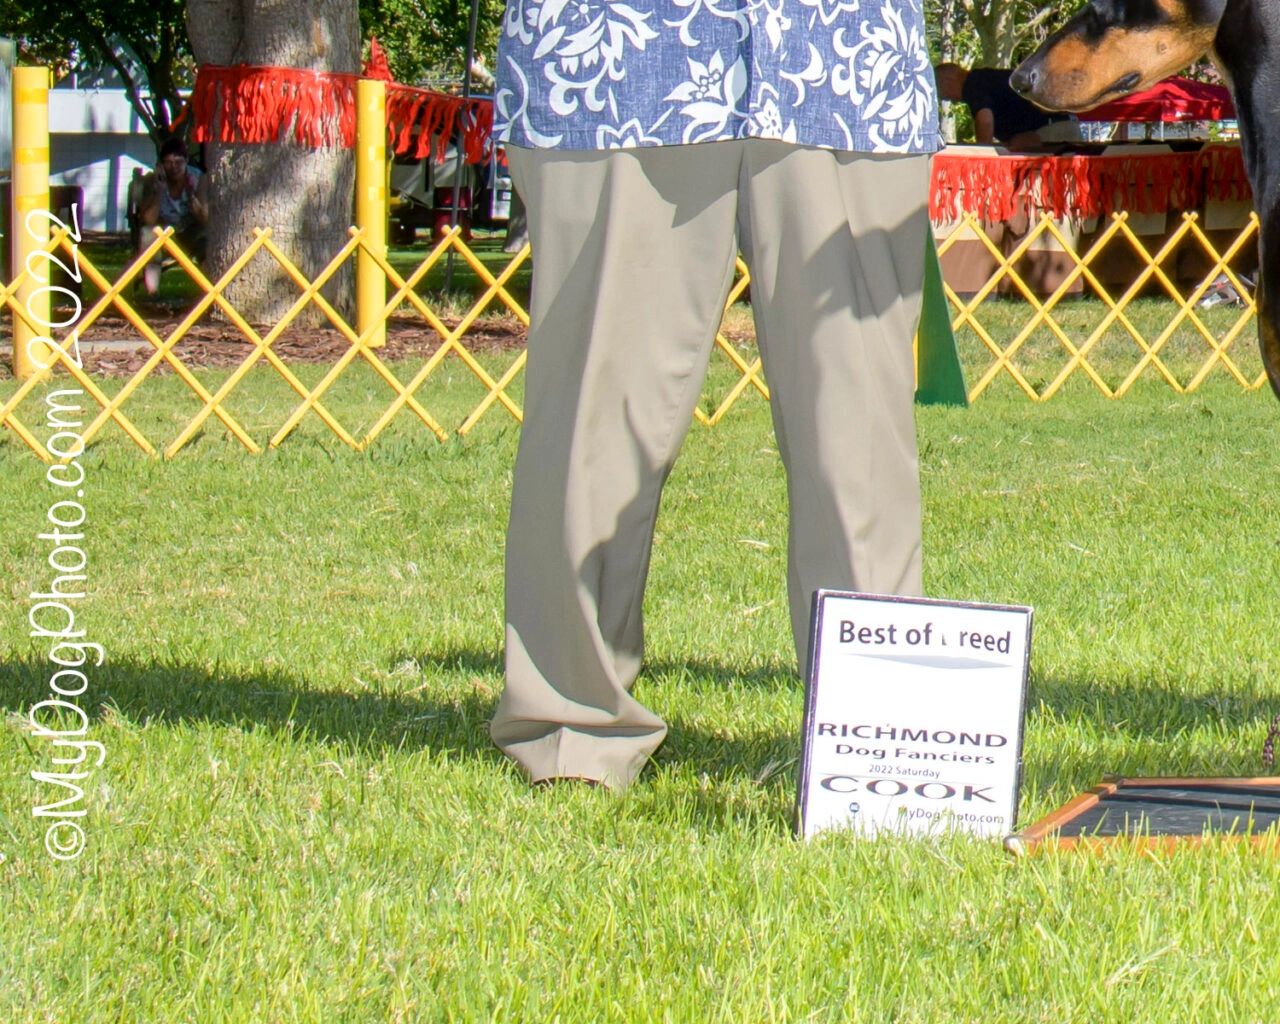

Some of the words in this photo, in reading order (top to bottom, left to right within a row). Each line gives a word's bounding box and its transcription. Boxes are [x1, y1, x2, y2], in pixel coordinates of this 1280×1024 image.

[839, 620, 897, 645] Best
[905, 622, 933, 646] of
[941, 629, 1011, 653] reed
[817, 722, 1008, 747] RICHMOND
[835, 744, 886, 760] Dog
[895, 748, 996, 765] Fanciers
[868, 764, 894, 775] 2022
[896, 766, 941, 780] Saturday
[820, 775, 997, 804] COOK
